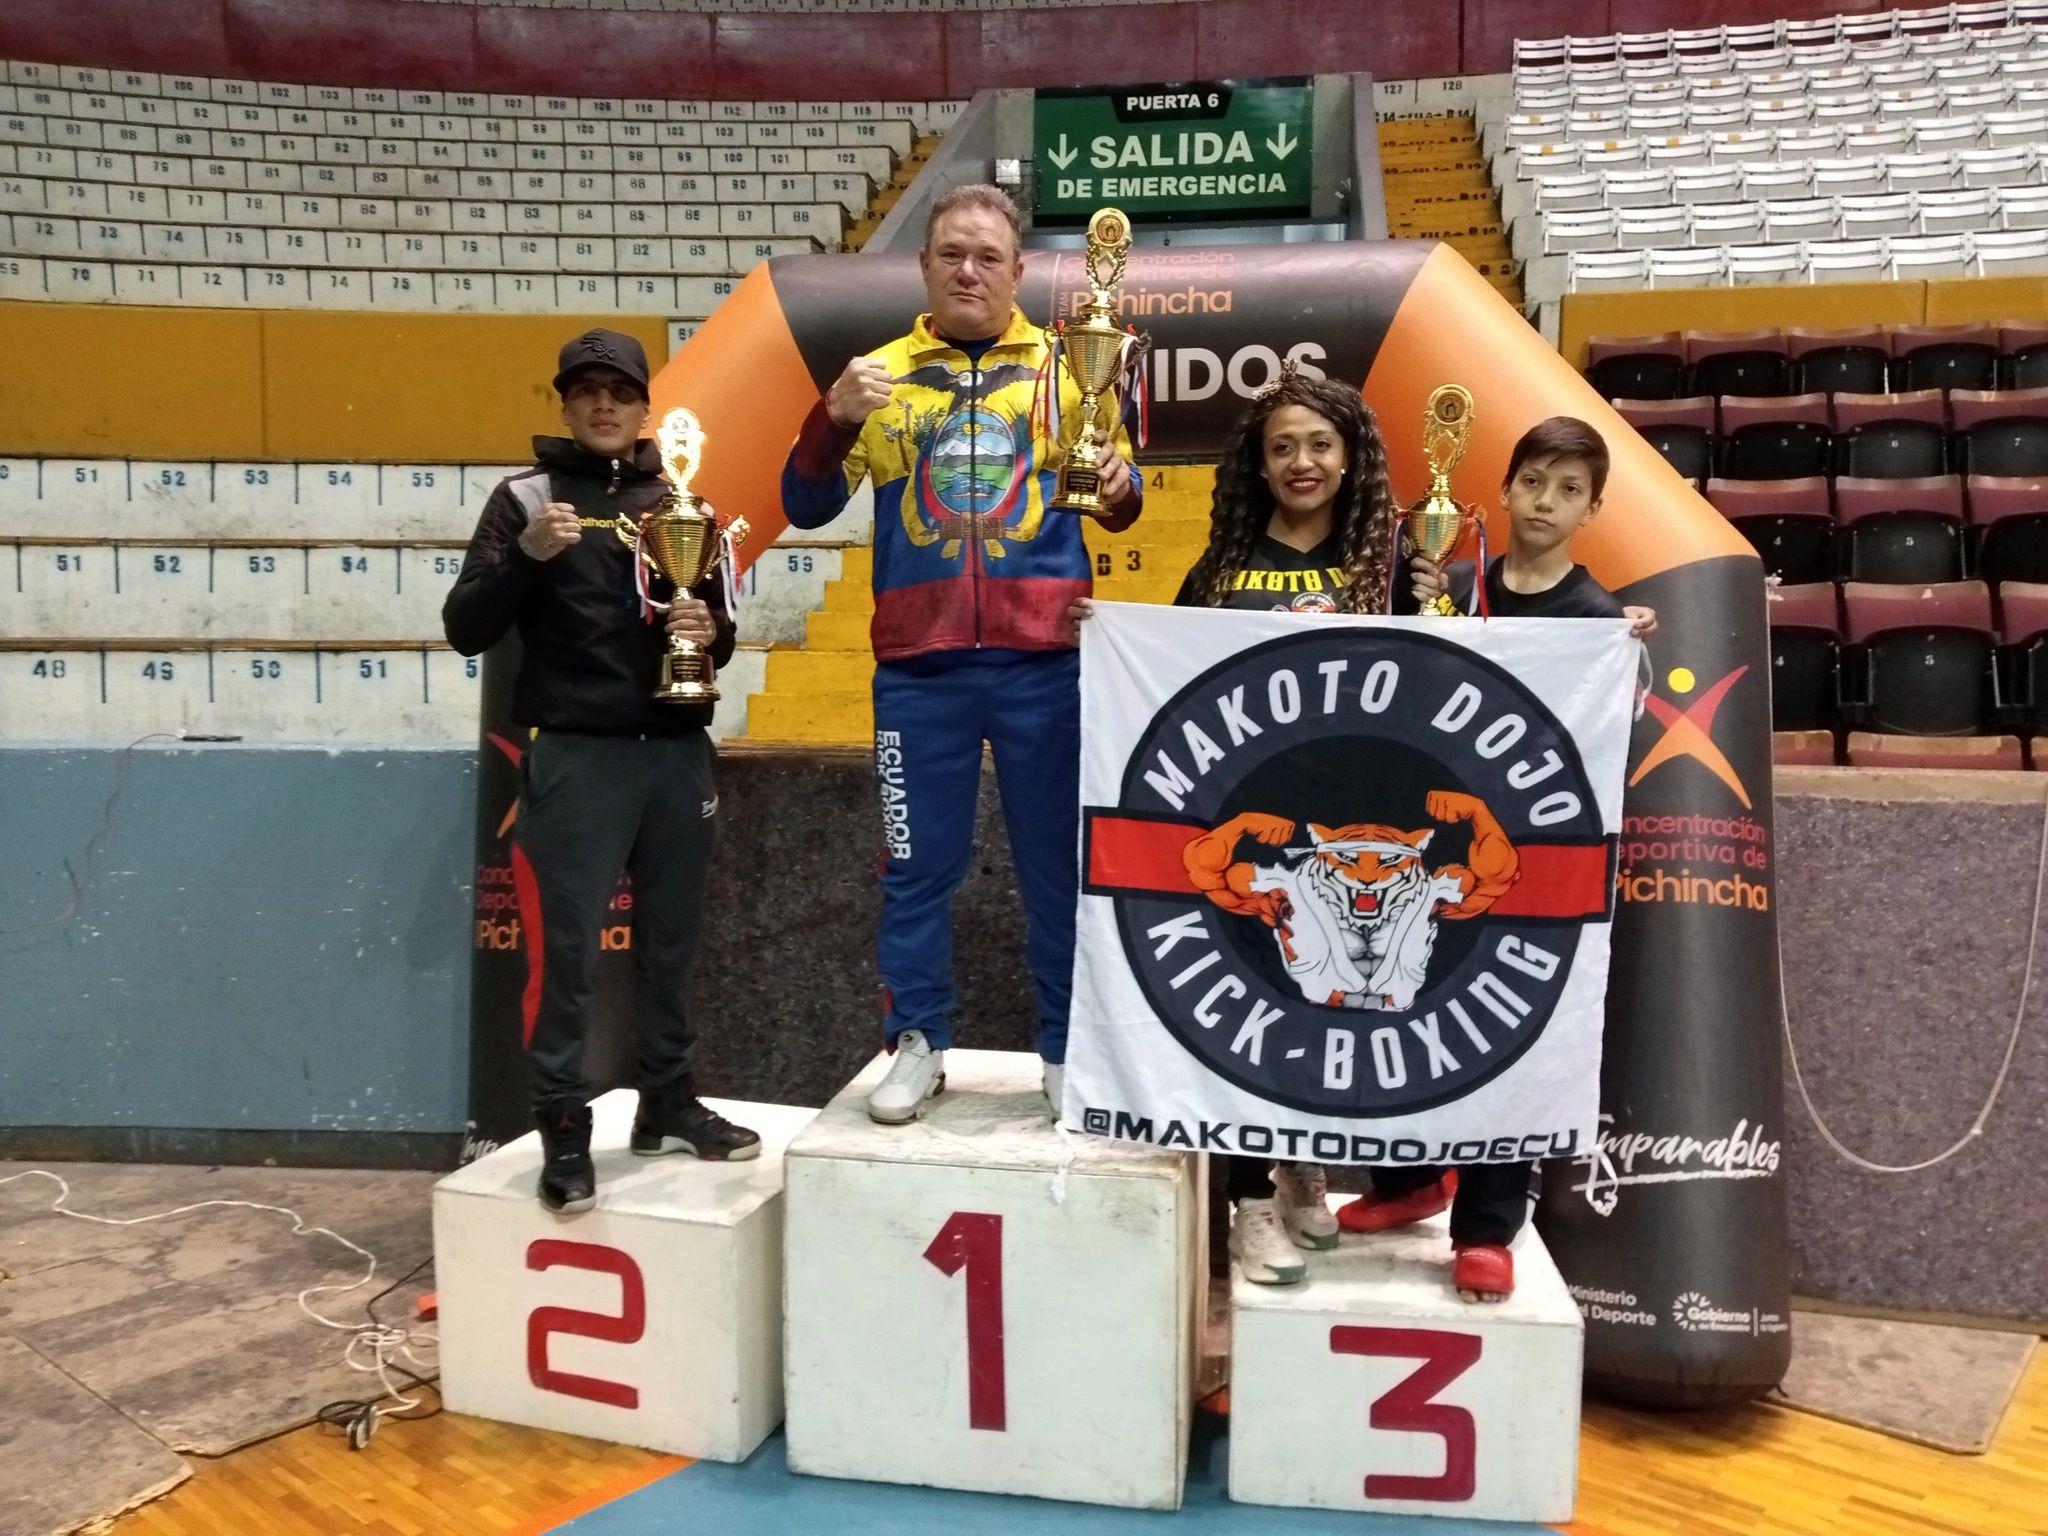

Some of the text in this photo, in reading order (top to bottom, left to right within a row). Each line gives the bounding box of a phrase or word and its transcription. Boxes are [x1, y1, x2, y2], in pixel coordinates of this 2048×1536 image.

[1127, 92, 1219, 111] PUERTA 6
[1383, 80, 1463, 95] 127 128
[1090, 130, 1254, 169] SALIDA
[1057, 173, 1287, 198] DE EMERGENCIA
[35, 221, 773, 257] 72 73 74 75 76 77 78 79 80 81 82 83 84
[1062, 251, 1234, 267] Centración
[71, 267, 90, 281] 70
[138, 269, 155, 282] 71
[203, 272, 222, 286] 72
[266, 272, 285, 286] 73
[330, 275, 348, 287] 74
[392, 276, 410, 290] 75
[454, 278, 471, 290] 76
[515, 279, 531, 291] 77
[578, 279, 596, 292] 78
[637, 280, 654, 294] 79
[713, 282, 731, 295] 80
[1071, 287, 1232, 318] Phincha
[1154, 342, 1327, 402] IDOS
[75, 467, 435, 488] 51 52 53 54 55
[1152, 471, 1165, 490] 4
[56, 554, 813, 575] 51 52 53 54 55 59
[1127, 550, 1141, 572] 3
[32, 659, 66, 679] 48
[142, 661, 174, 681] 49
[251, 659, 281, 680] 50
[359, 658, 387, 679] 51
[1143, 659, 1581, 828] MAKOTO DOJO
[883, 731, 911, 860] ECUADOR
[1622, 814, 1766, 843] ncentración
[1743, 848, 1767, 870] de
[1083, 1107, 1578, 1164] @MAKOTODOJOECU
[526, 1238, 646, 1410] 2
[921, 1211, 1006, 1432] 1
[1591, 1304, 1657, 1326] Deporte
[1330, 1325, 1483, 1501] 3
